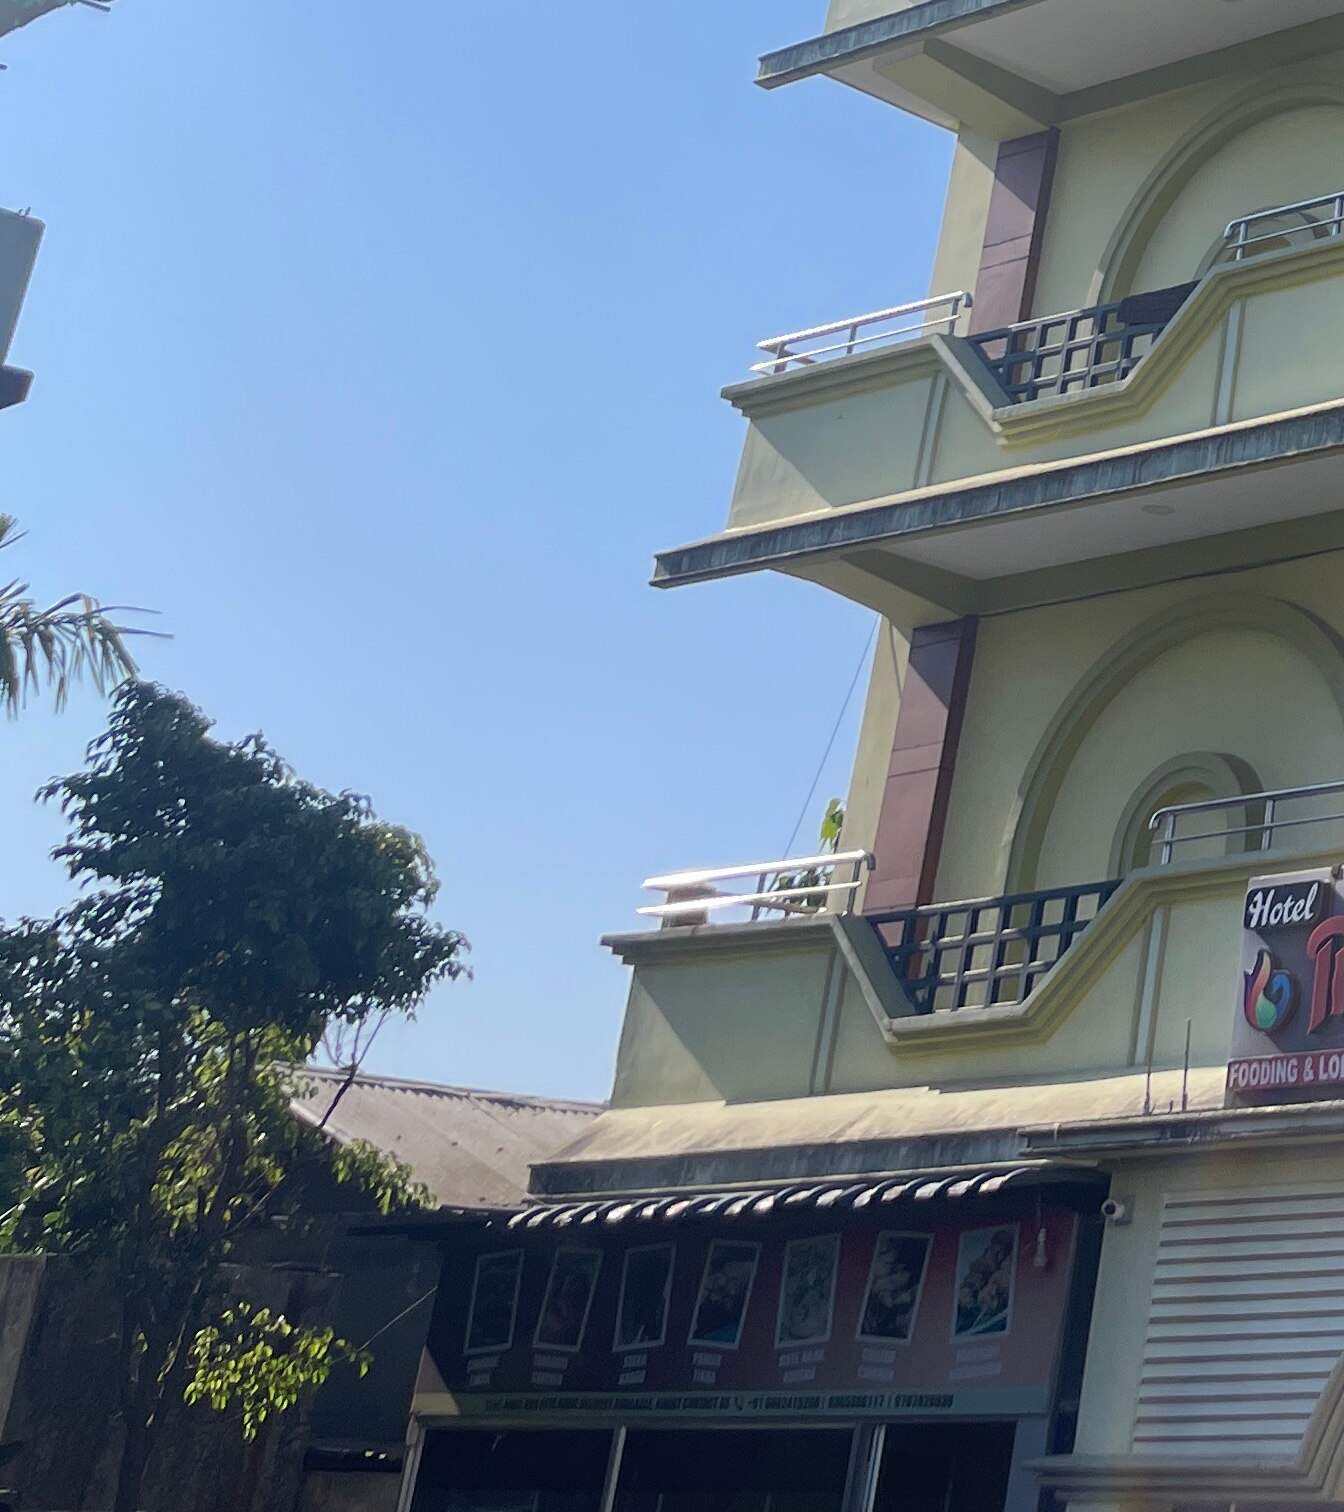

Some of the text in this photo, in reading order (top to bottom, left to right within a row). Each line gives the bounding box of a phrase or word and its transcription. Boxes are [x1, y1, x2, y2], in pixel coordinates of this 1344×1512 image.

[1249, 882, 1319, 928] Hotel
[1229, 1058, 1298, 1087] FOODING
[1303, 1058, 1314, 1082] &
